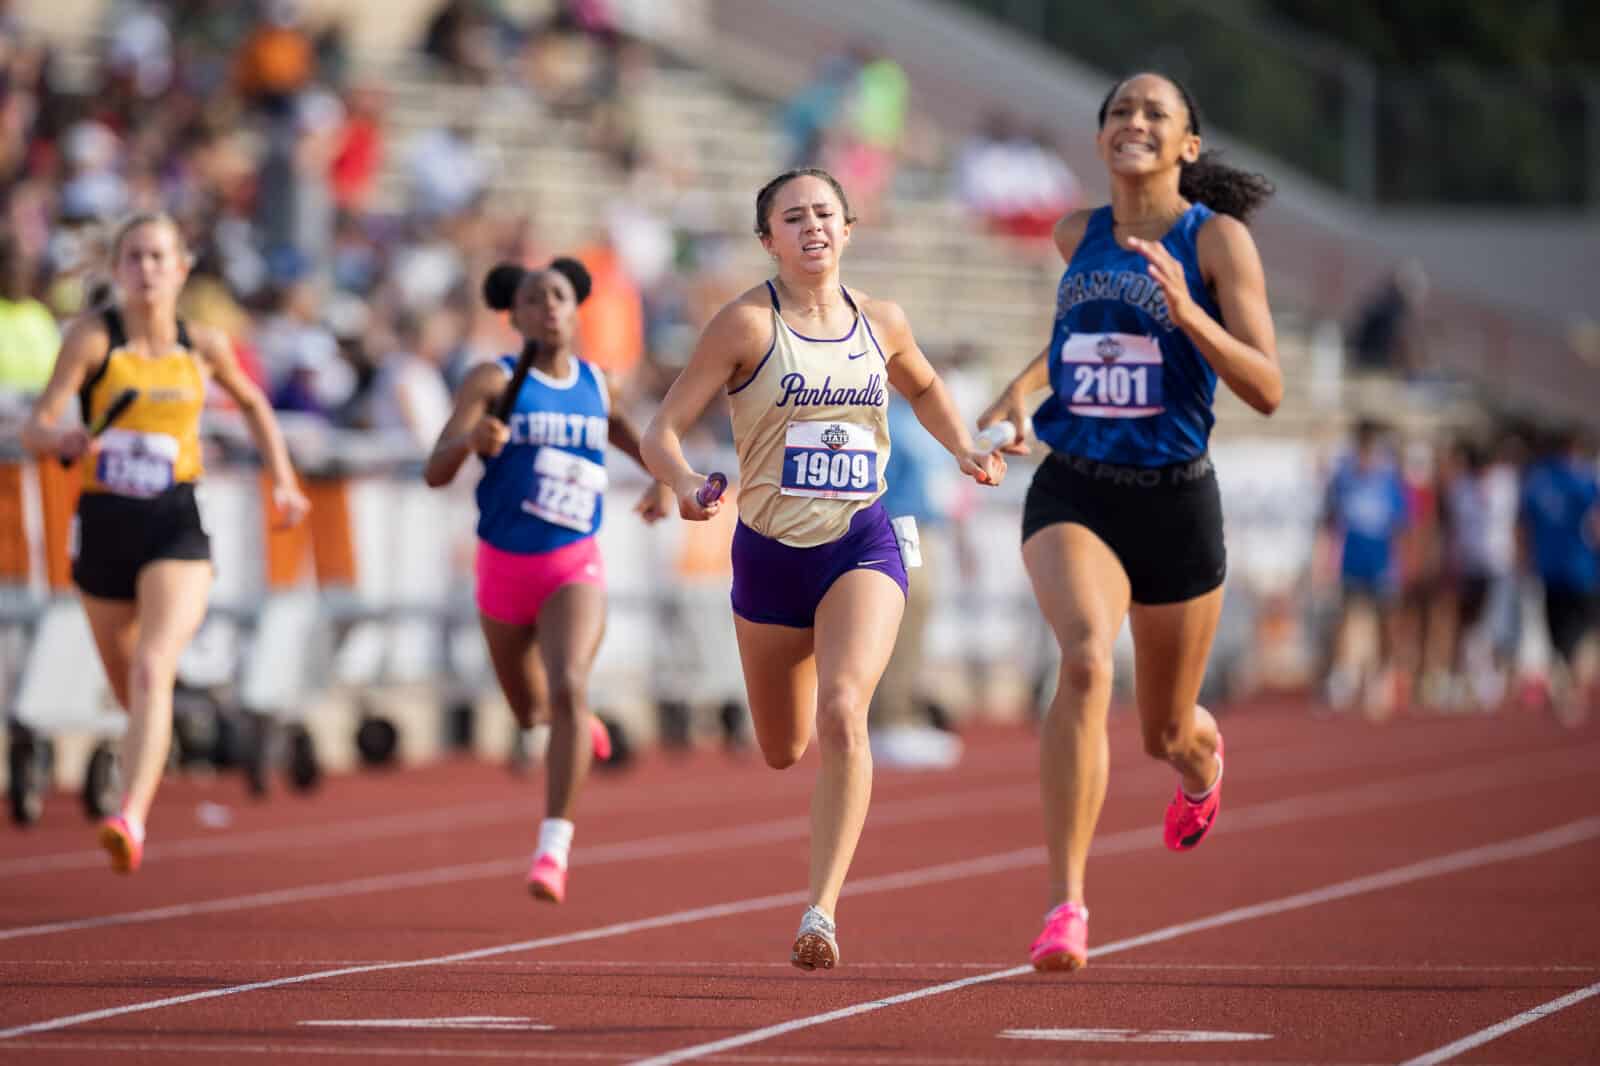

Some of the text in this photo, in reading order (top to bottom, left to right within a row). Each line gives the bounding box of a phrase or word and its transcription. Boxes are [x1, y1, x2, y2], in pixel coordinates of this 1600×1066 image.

[776, 373, 885, 407] Panhandle
[1071, 365, 1148, 405] 2101
[793, 452, 869, 489] 1909
